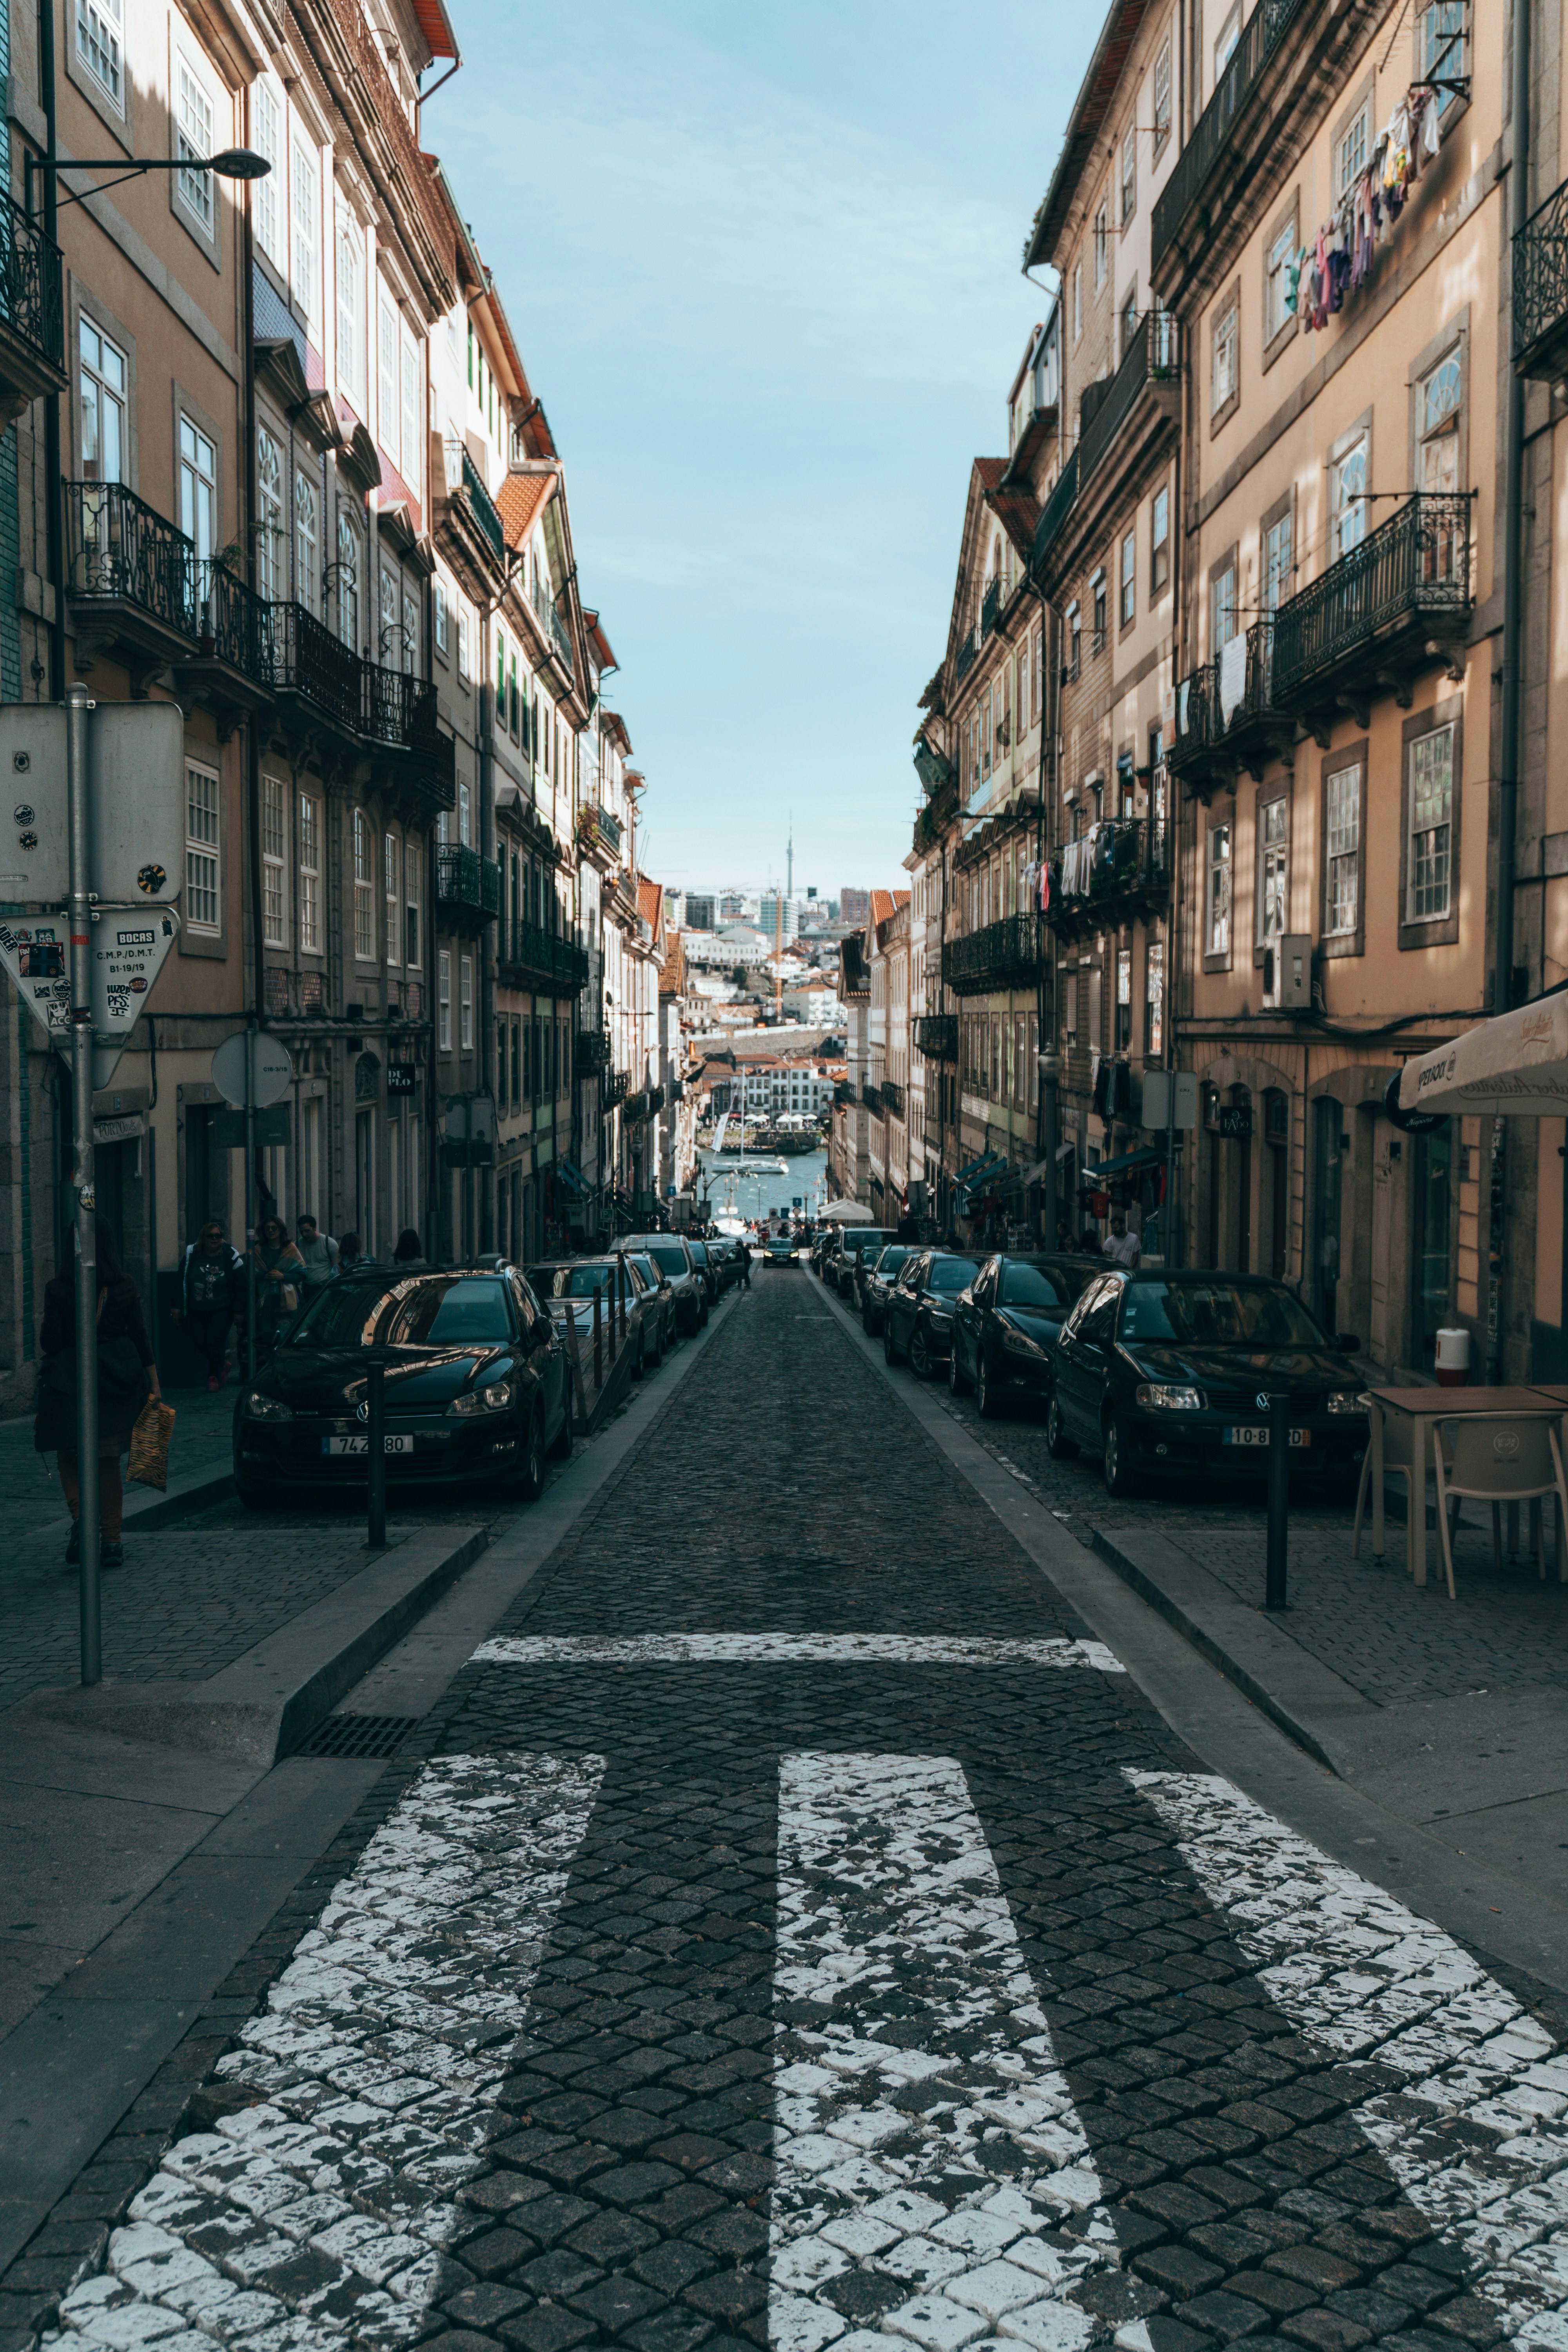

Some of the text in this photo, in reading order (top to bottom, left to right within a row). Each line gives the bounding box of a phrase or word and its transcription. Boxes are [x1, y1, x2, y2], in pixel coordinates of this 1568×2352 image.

[119, 933, 152, 943] BOCAS
[97, 949, 155, 960] C.M.P./D.M.T.
[110, 964, 145, 973] B1-19/19
[388, 1078, 410, 1086] PLO
[1224, 1117, 1249, 1131] FADO
